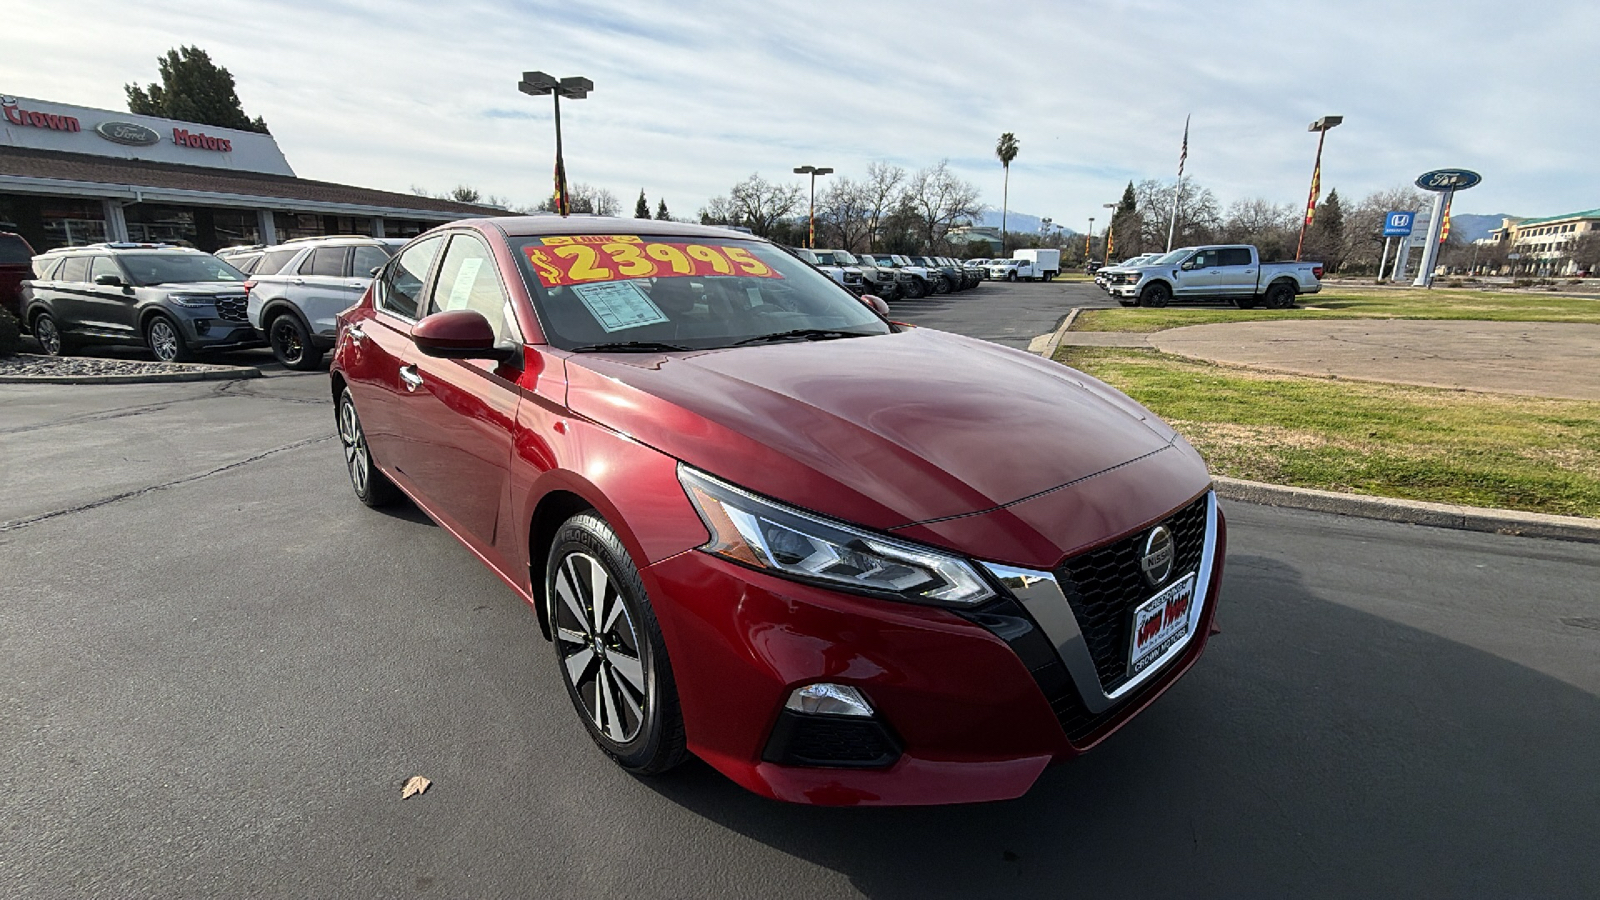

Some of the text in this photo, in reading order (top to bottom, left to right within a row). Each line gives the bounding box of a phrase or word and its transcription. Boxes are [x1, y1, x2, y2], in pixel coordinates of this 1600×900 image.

[3, 105, 233, 152] Crown Ford Motors
[531, 243, 772, 284] $23995
[561, 529, 604, 556] VELOCITY
[1134, 646, 1161, 672] CROWN
[1161, 627, 1186, 655] MOTORS
